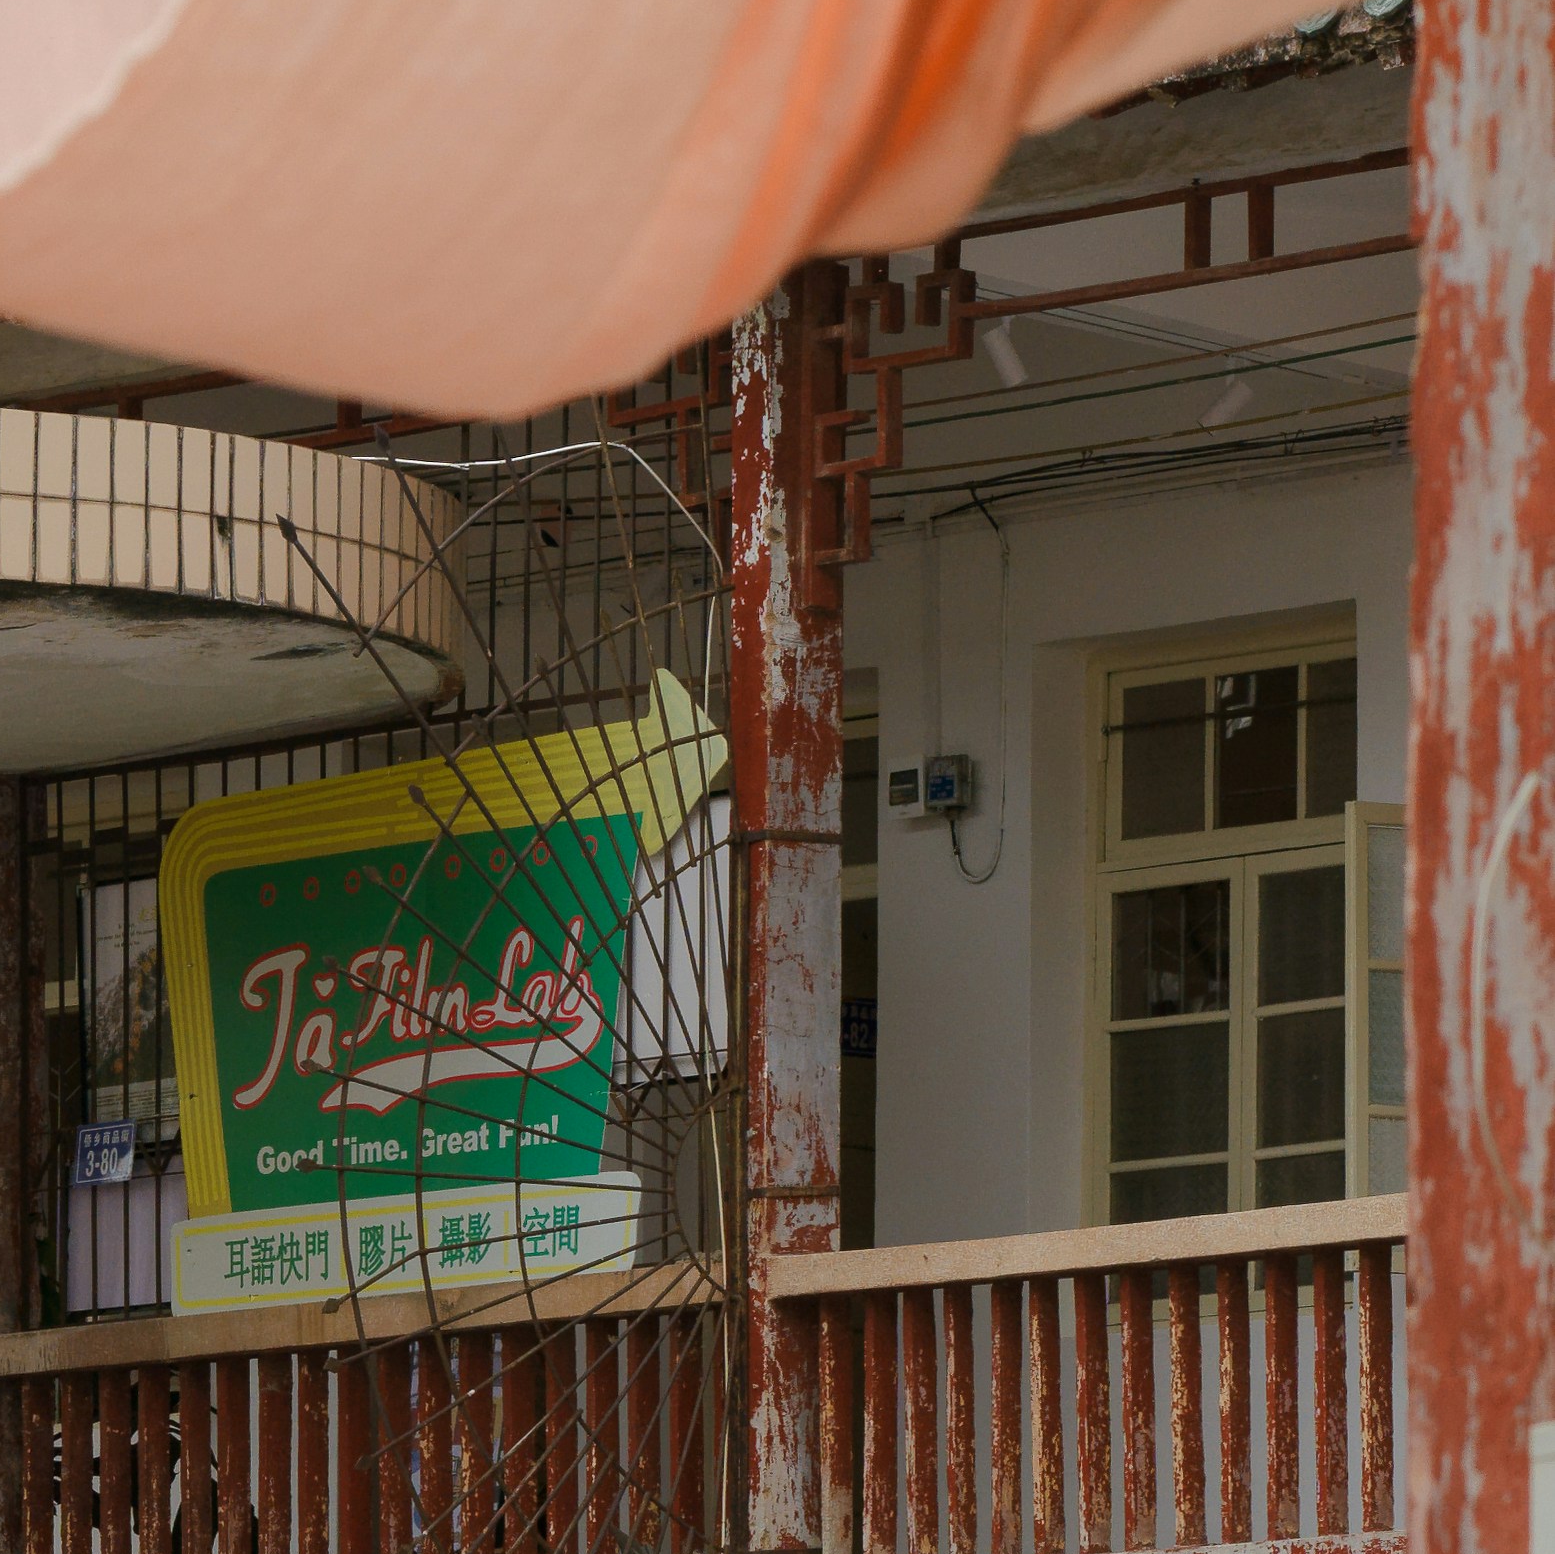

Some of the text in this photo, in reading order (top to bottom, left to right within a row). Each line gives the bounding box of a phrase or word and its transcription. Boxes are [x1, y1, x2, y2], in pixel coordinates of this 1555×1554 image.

[340, 933, 469, 1050] Film
[469, 913, 596, 1033] Lab
[85, 1147, 119, 1177] 3-80
[257, 1140, 323, 1175] Good
[421, 1122, 490, 1158] Great
[498, 1114, 559, 1149] Fun!
[224, 1204, 580, 1289] 耳語快門 膠片 攝影 空間
